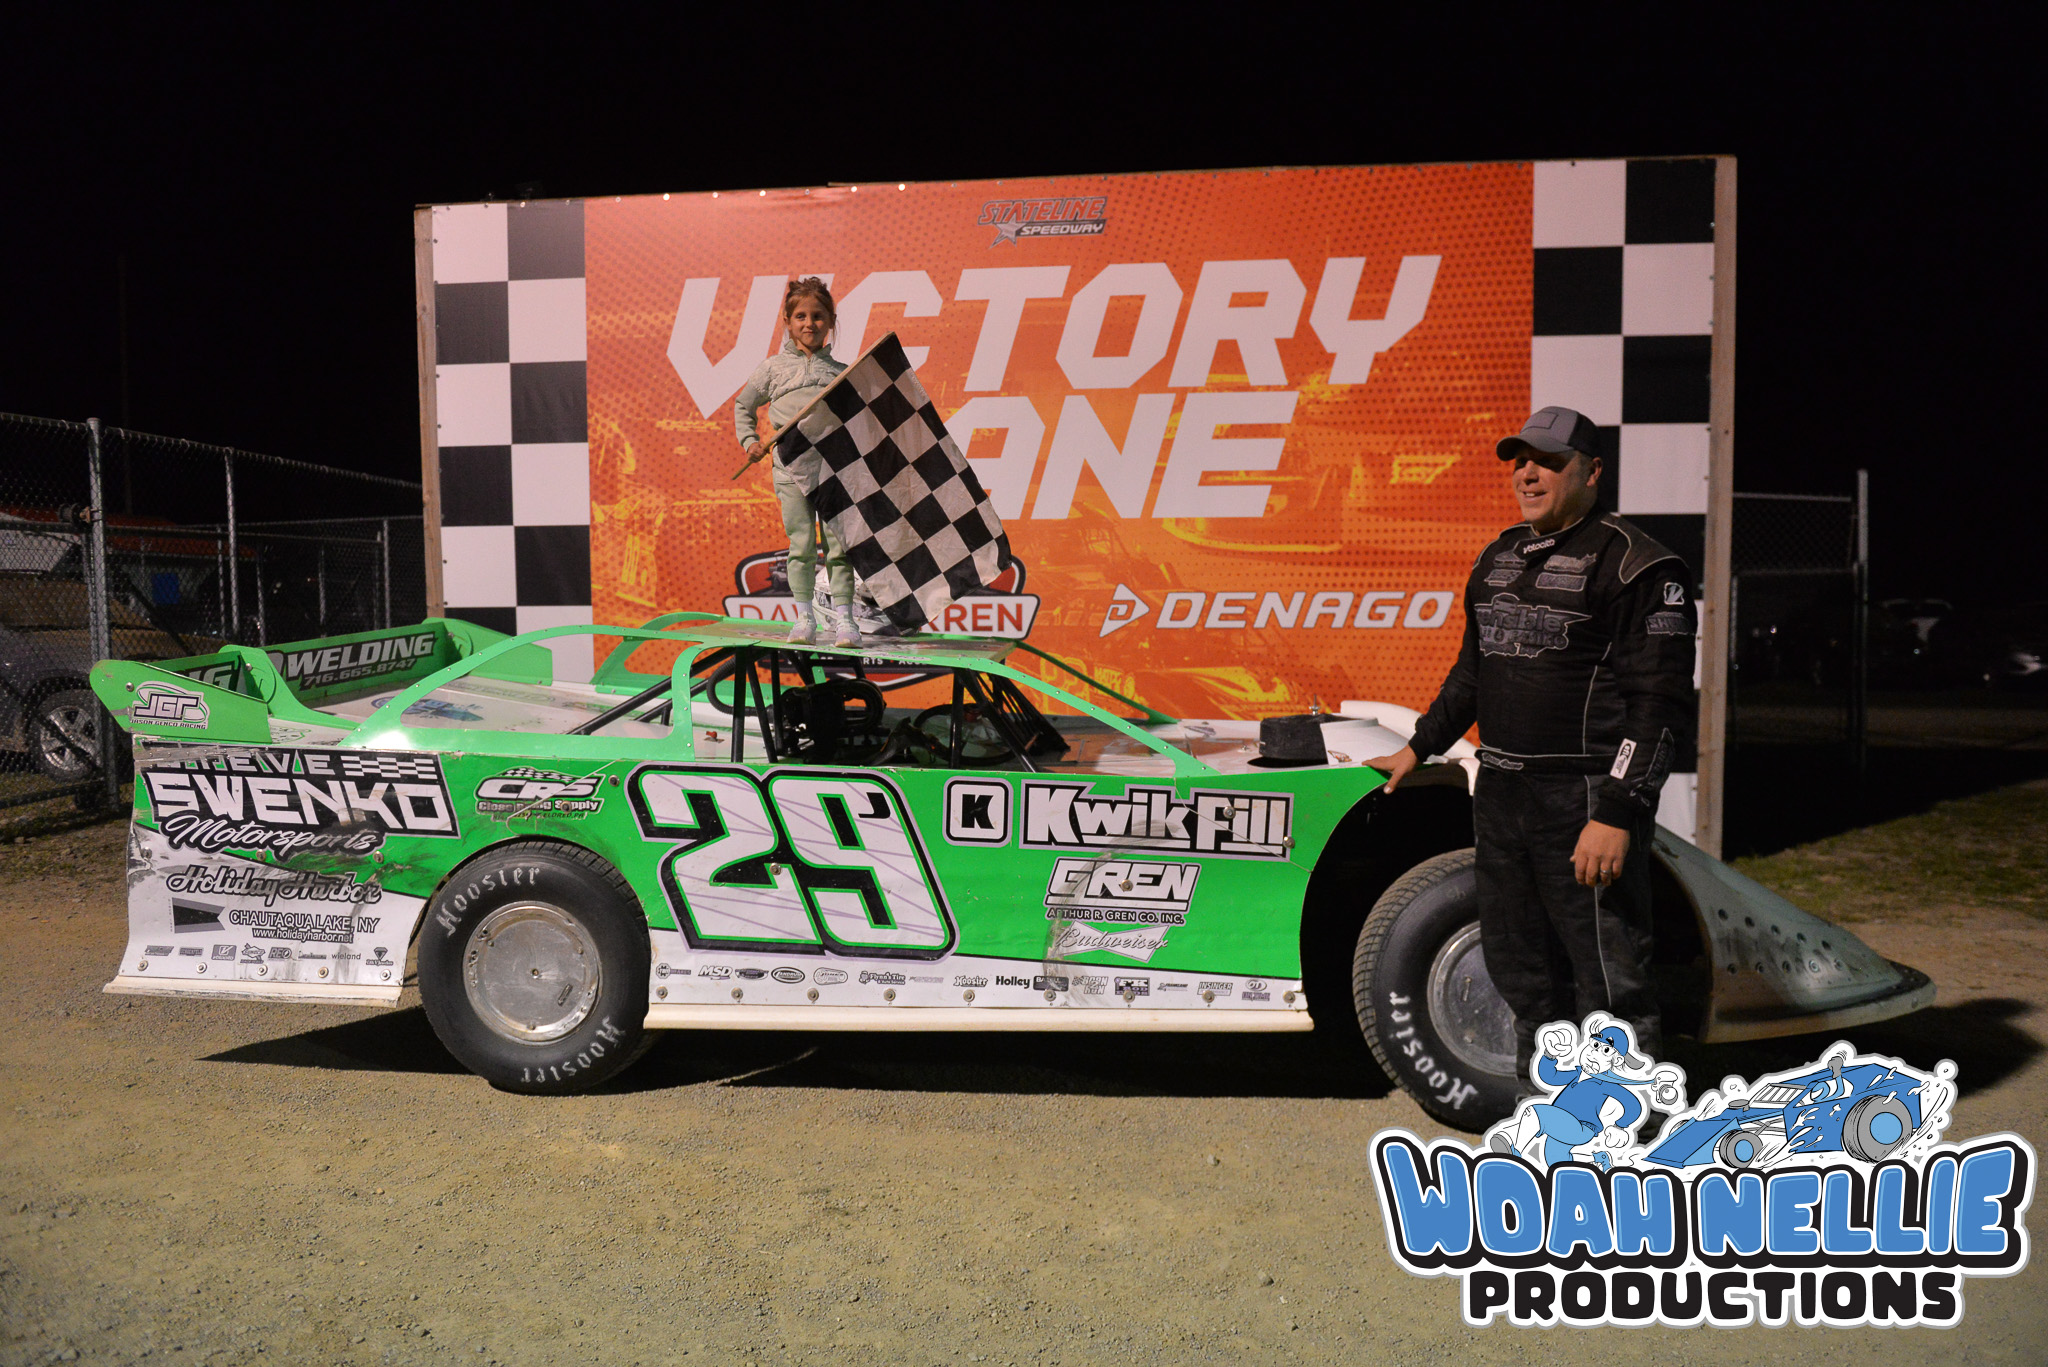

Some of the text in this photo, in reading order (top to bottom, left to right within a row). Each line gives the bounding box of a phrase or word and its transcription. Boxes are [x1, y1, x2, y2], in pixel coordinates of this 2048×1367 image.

[978, 197, 1107, 225] STATELINE
[1020, 223, 1104, 236] SPEEDWAY
[667, 255, 1442, 419] VCTORY
[943, 391, 1299, 519] ANE
[1156, 591, 1455, 629] DENAGO
[287, 634, 435, 678] WELDING
[303, 657, 417, 688] 716.665.8747
[146, 772, 453, 832] SWENKO
[477, 777, 600, 800] CRS
[554, 800, 599, 813] Spply
[961, 794, 995, 829] K
[1026, 787, 1288, 852] Kwik Fill
[165, 814, 380, 856] Motorsports
[632, 769, 952, 954] 29
[167, 864, 279, 905] Holiday
[1048, 858, 1200, 903] GREN
[436, 866, 540, 938] Hoosier
[1106, 910, 1137, 922] GREN
[1138, 912, 1159, 923] CO.
[1161, 914, 1185, 924] INC.
[229, 909, 381, 934] CHAUTAQUA LAKE, NY
[252, 927, 354, 944] www.holidayharbor.net
[1054, 928, 1169, 950] Budweiser
[332, 952, 362, 961] wieland
[698, 965, 733, 977] MSD
[953, 975, 988, 987] Hoosier
[995, 975, 1031, 989] Holley
[1199, 981, 1234, 990] INSINGER
[520, 1015, 626, 1084] Hoosier
[1389, 991, 1479, 1110] Hoosier
